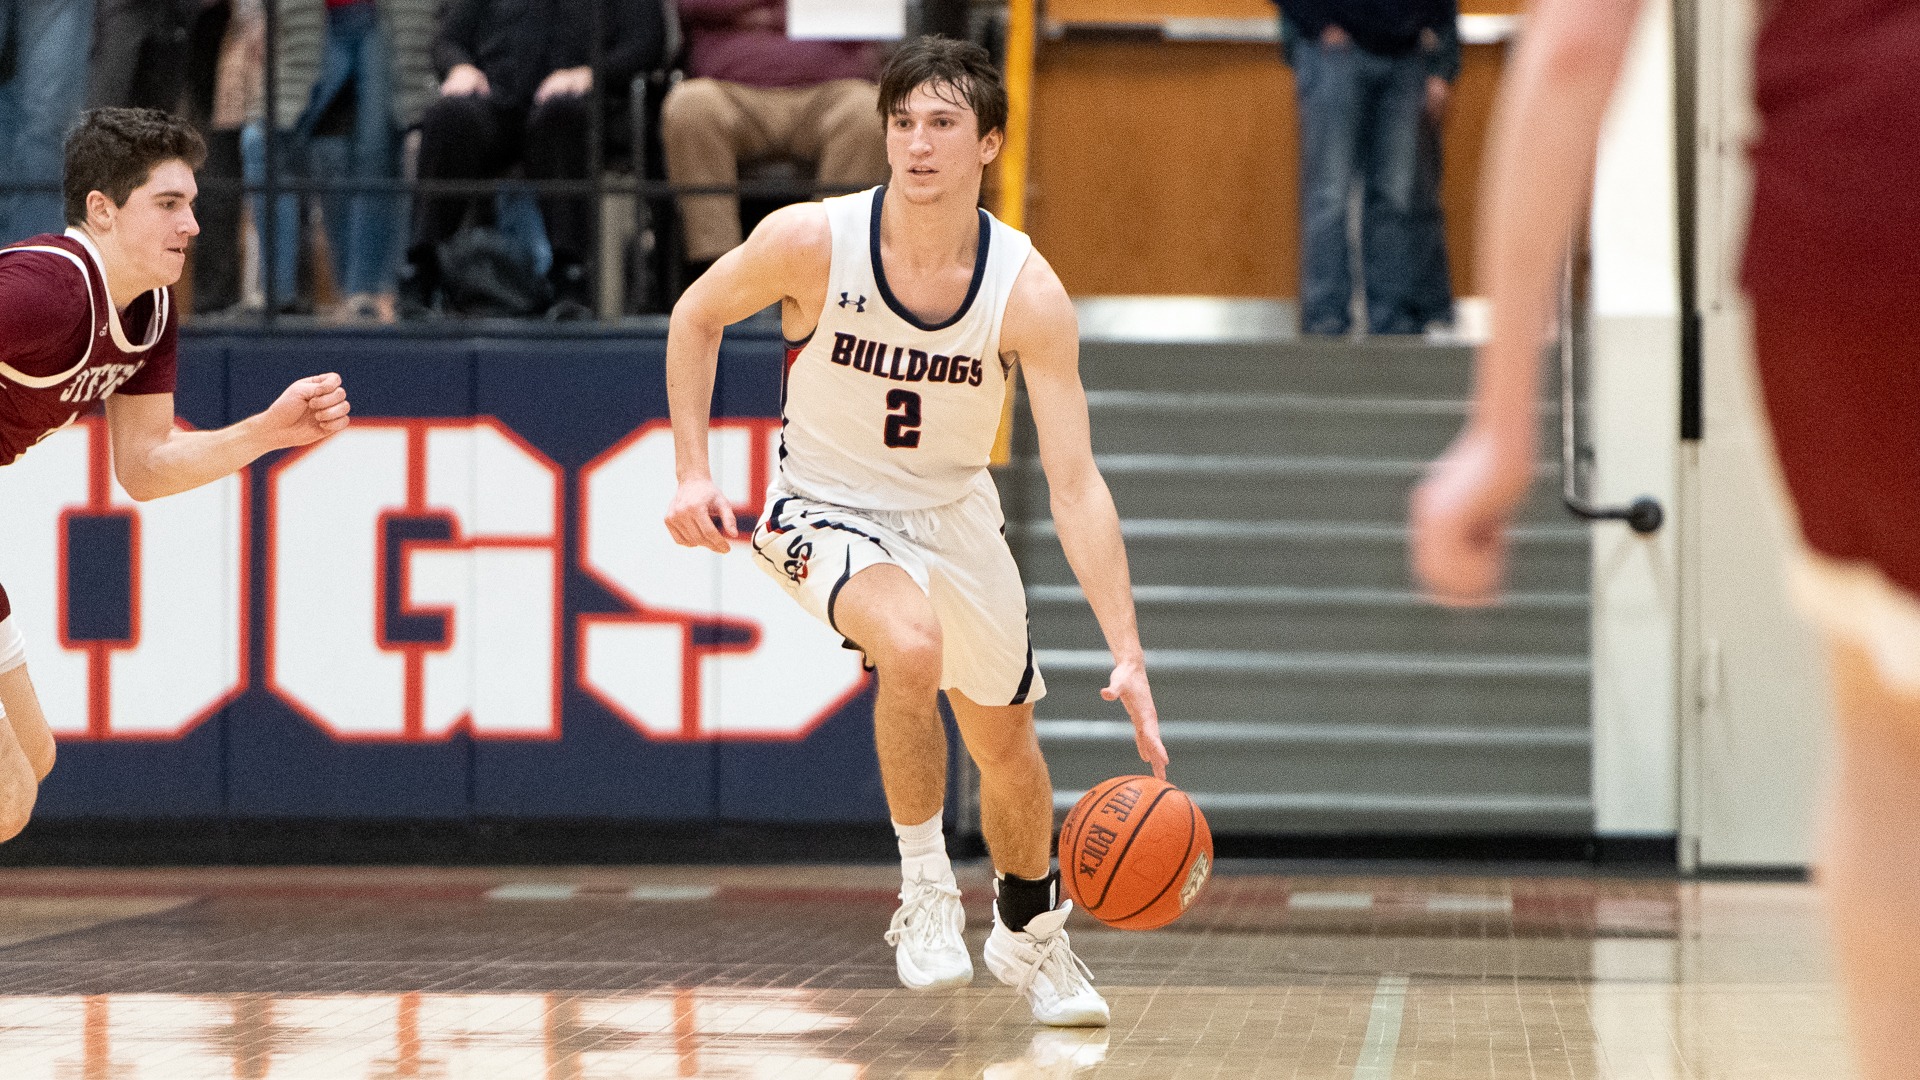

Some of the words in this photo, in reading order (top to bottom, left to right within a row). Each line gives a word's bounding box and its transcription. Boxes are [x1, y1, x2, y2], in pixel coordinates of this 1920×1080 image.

[831, 332, 983, 387] BULLDOGS
[884, 388, 922, 448] 2
[1101, 786, 1143, 823] THE
[1080, 821, 1118, 880] ROCK
